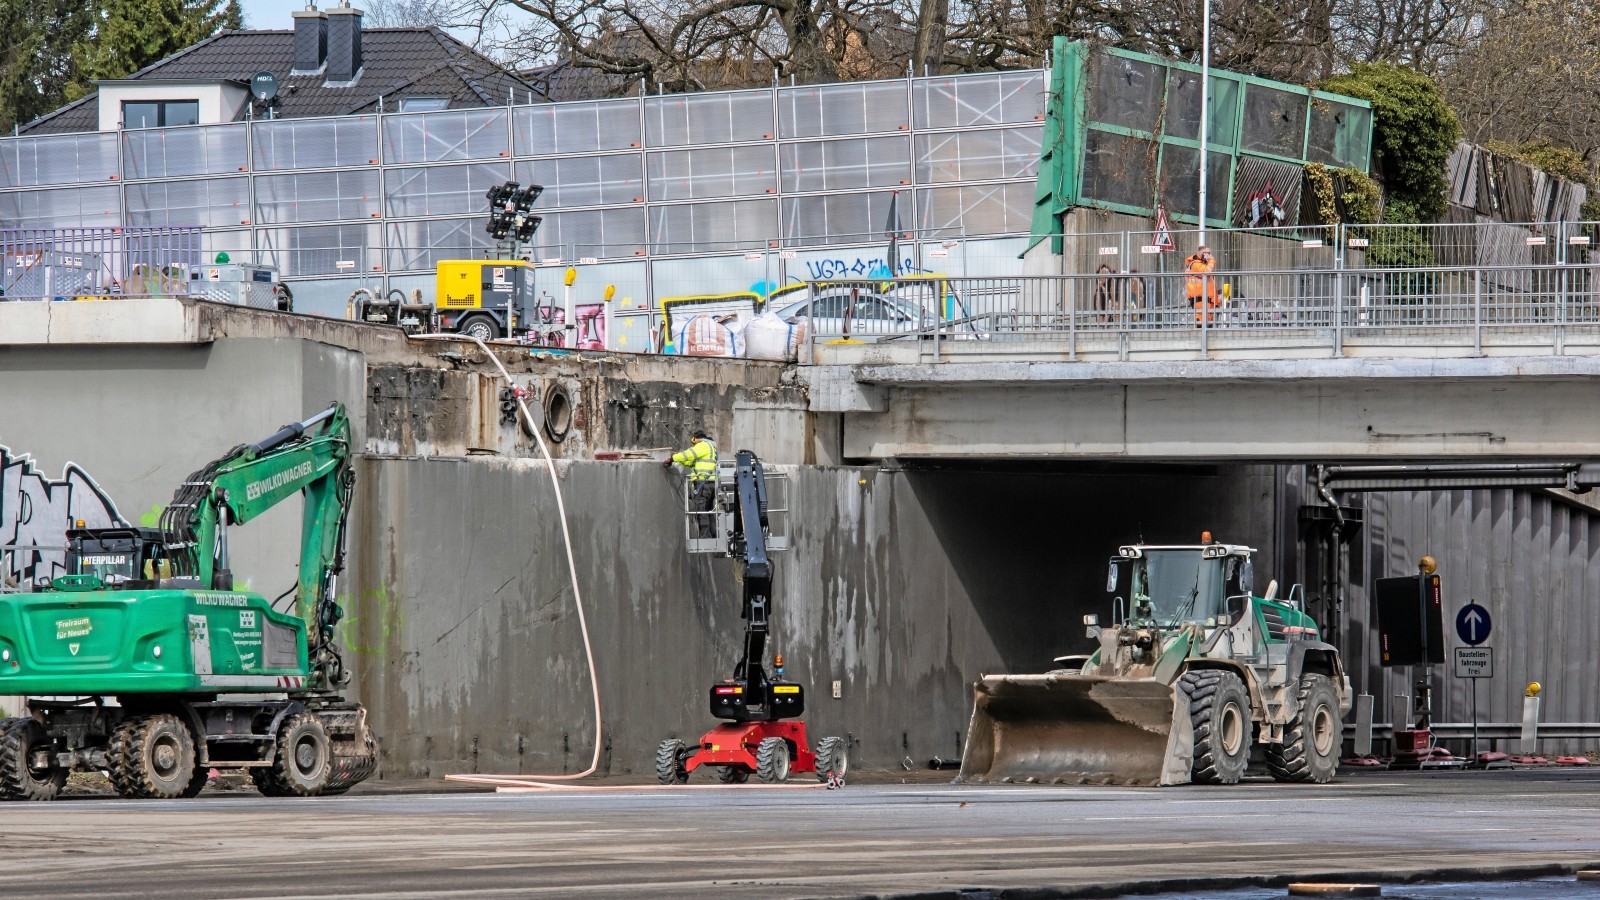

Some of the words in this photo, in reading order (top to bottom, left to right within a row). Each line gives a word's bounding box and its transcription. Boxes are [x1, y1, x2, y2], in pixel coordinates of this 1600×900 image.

[690, 344, 725, 352] KEMNA
[260, 473, 281, 495] WILKO
[281, 460, 313, 485] WAGNER
[218, 594, 248, 607] WAGNER
[1461, 659, 1487, 668] fahrzeuge
[1468, 667, 1481, 675] frei
